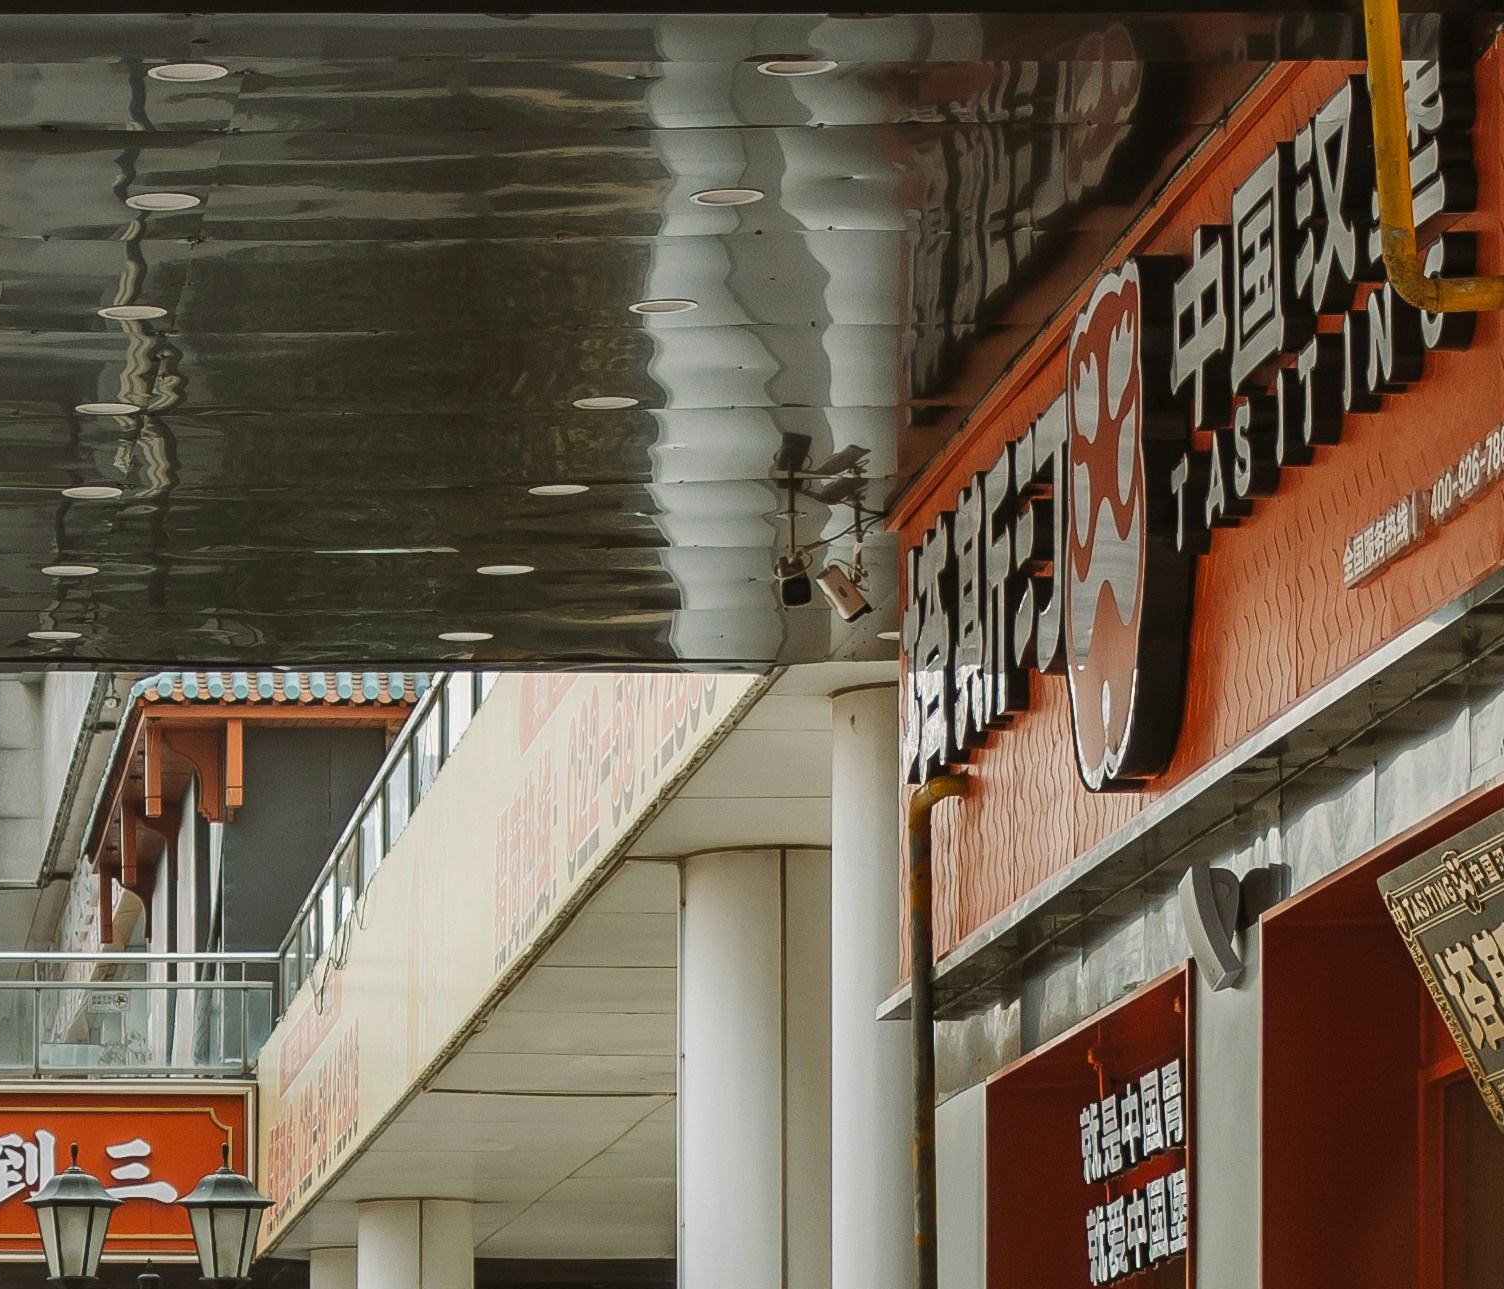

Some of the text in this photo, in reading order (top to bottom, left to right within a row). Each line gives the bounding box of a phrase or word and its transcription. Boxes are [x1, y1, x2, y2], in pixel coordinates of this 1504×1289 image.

[1173, 247, 1445, 553] TASITING
[903, 400, 1067, 784] 塔斯汀
[1342, 503, 1409, 583] 全国服务热线
[1402, 877, 1457, 924] TASITING
[1081, 1057, 1184, 1180] 就是中国胃
[1086, 1167, 1188, 1285] 就爱中国堡
